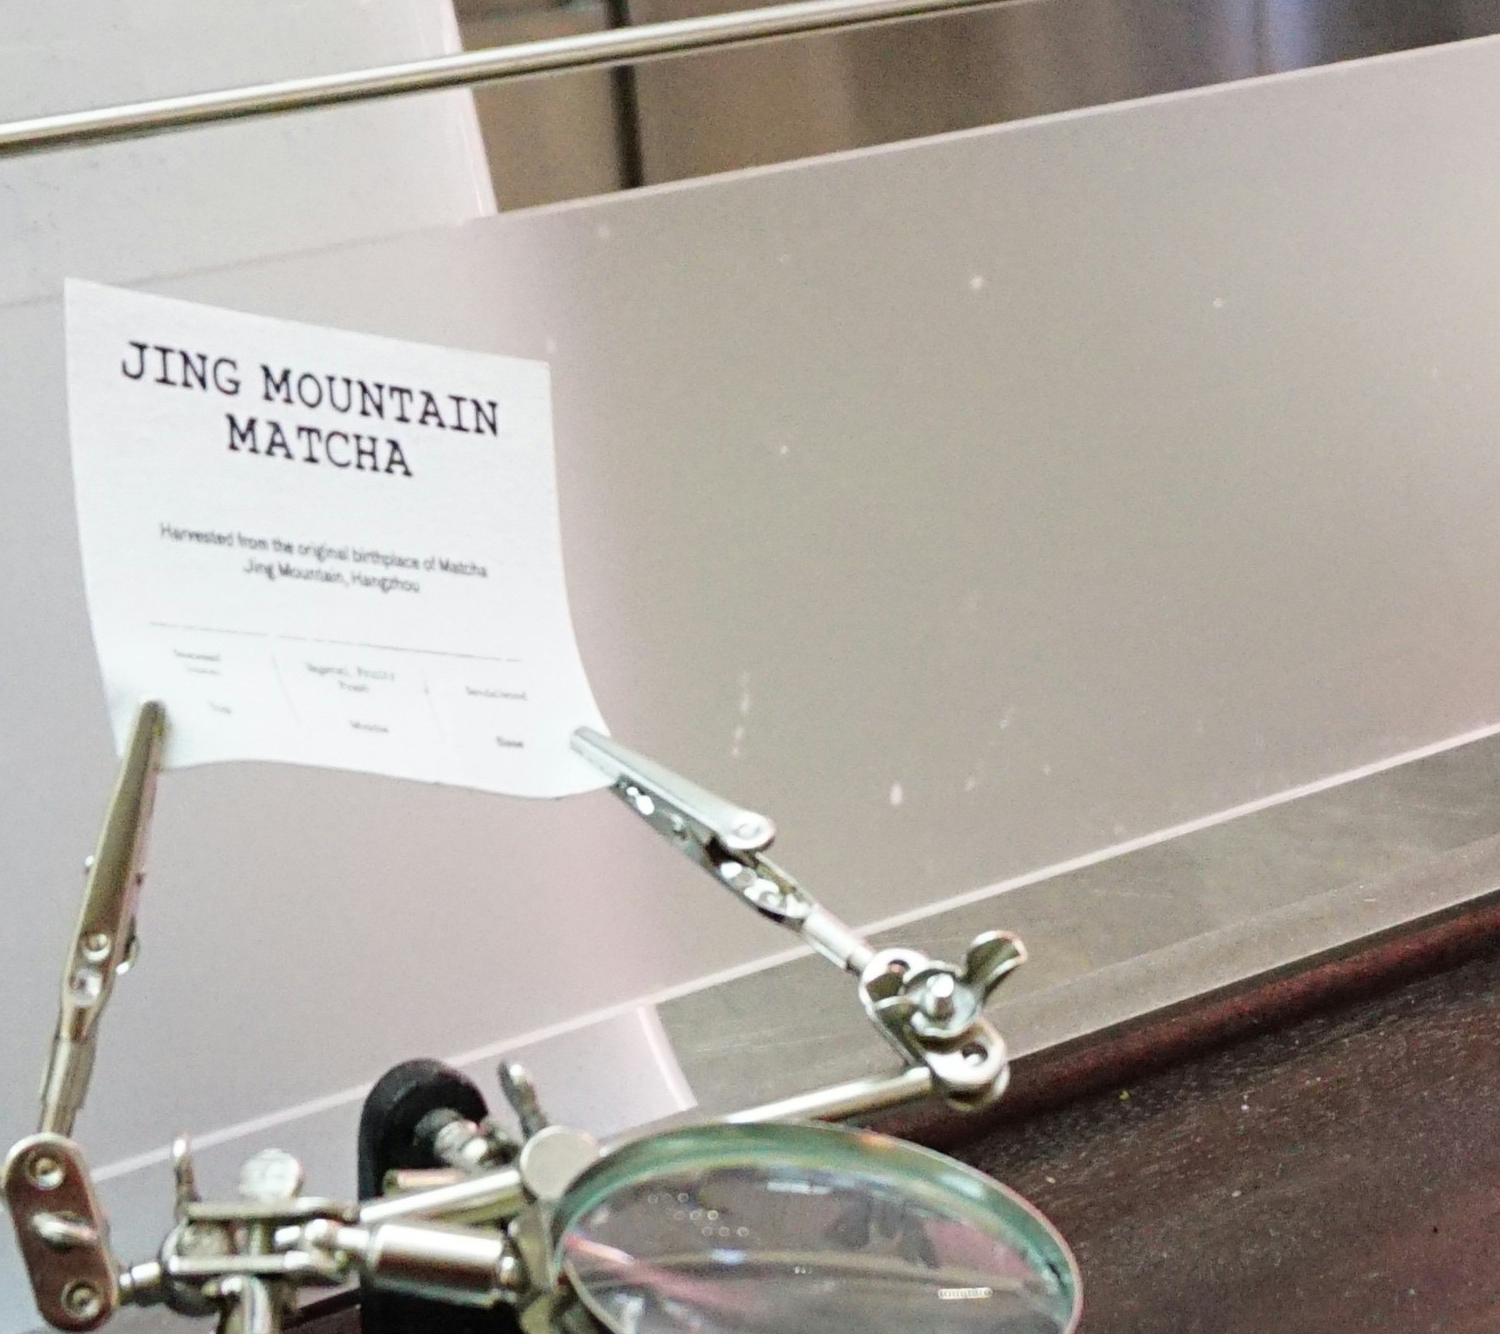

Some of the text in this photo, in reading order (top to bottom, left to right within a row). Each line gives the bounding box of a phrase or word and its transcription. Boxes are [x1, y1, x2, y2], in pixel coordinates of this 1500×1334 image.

[121, 340, 499, 438] JING MOUNTAIN
[225, 412, 414, 478] MATCHA
[160, 521, 234, 547] Harvested
[237, 530, 269, 551] from
[271, 535, 294, 555] the
[297, 539, 349, 564] original
[351, 545, 421, 571] birthplace
[243, 556, 276, 582] Jing
[351, 570, 421, 595] Hangzhou
